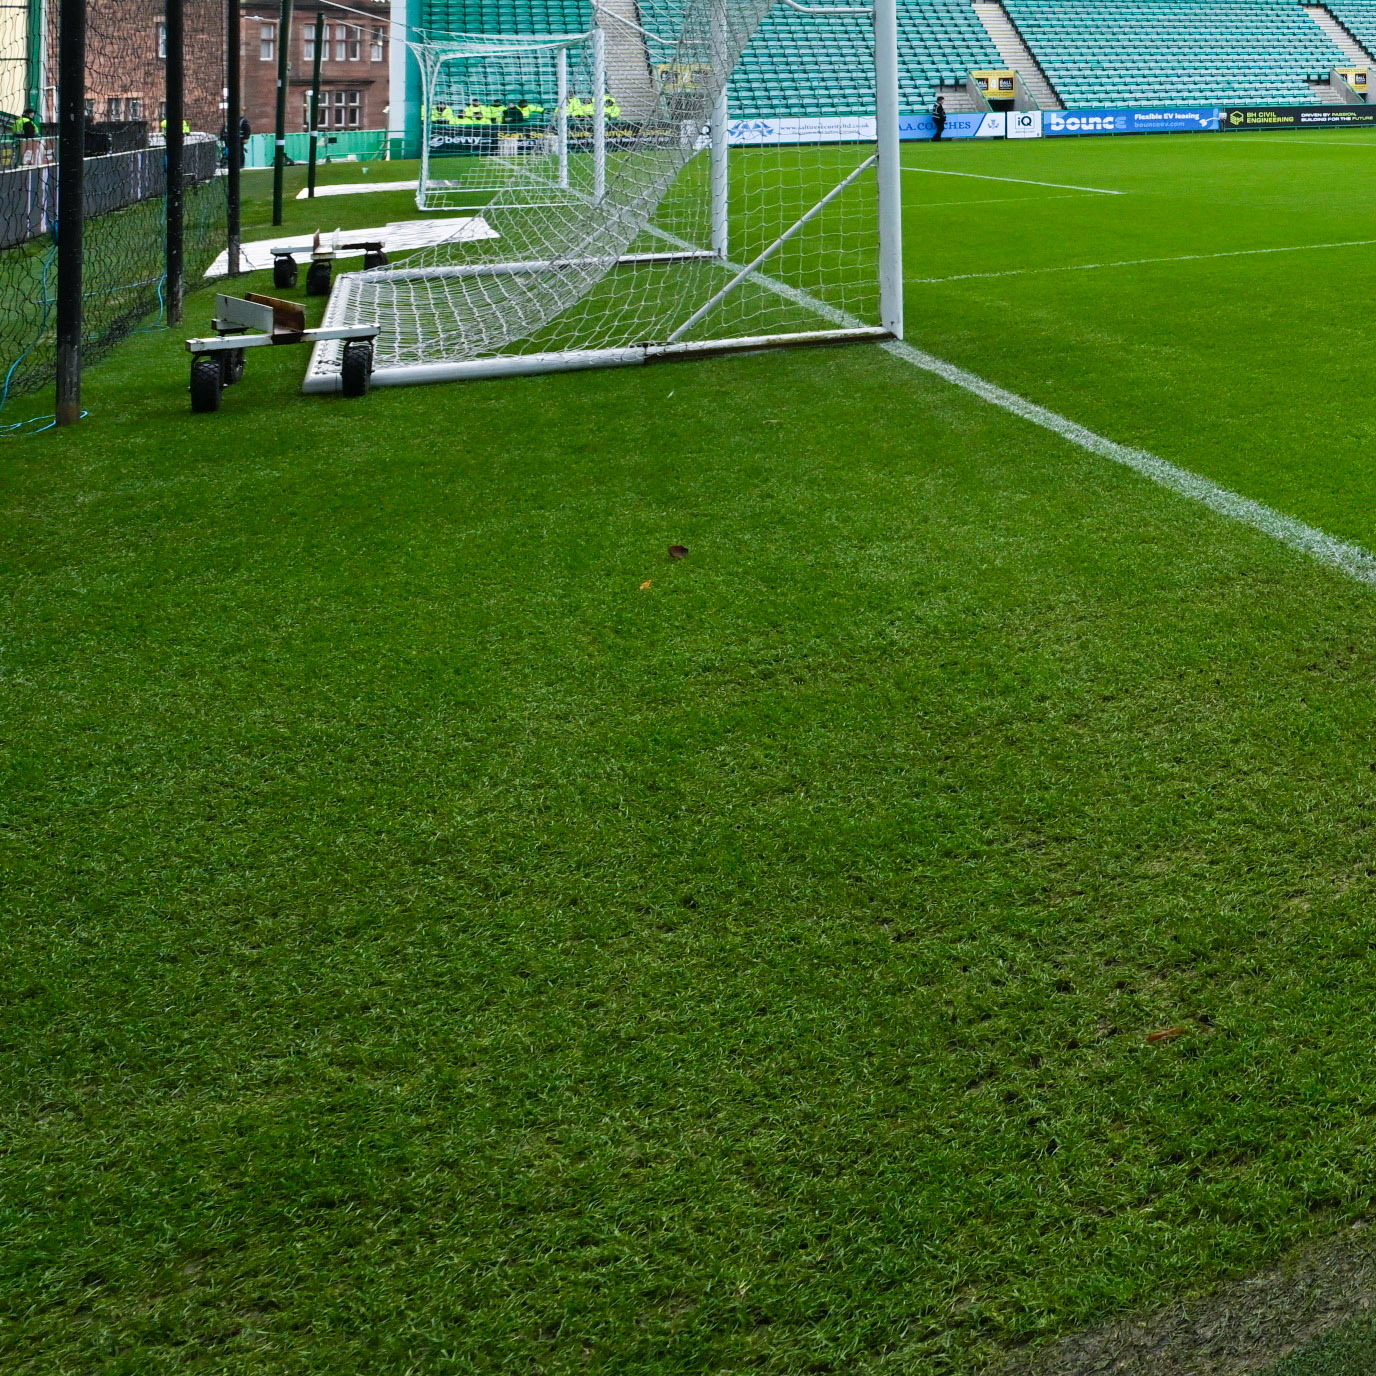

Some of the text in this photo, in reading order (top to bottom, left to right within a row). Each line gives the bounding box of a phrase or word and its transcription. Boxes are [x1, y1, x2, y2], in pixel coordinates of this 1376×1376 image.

[1018, 116, 1032, 126] iQ
[1050, 112, 1127, 131] bounce
[1174, 112, 1200, 122] leasing
[1246, 116, 1294, 124] ENGINEERING
[917, 121, 970, 131] COCHES
